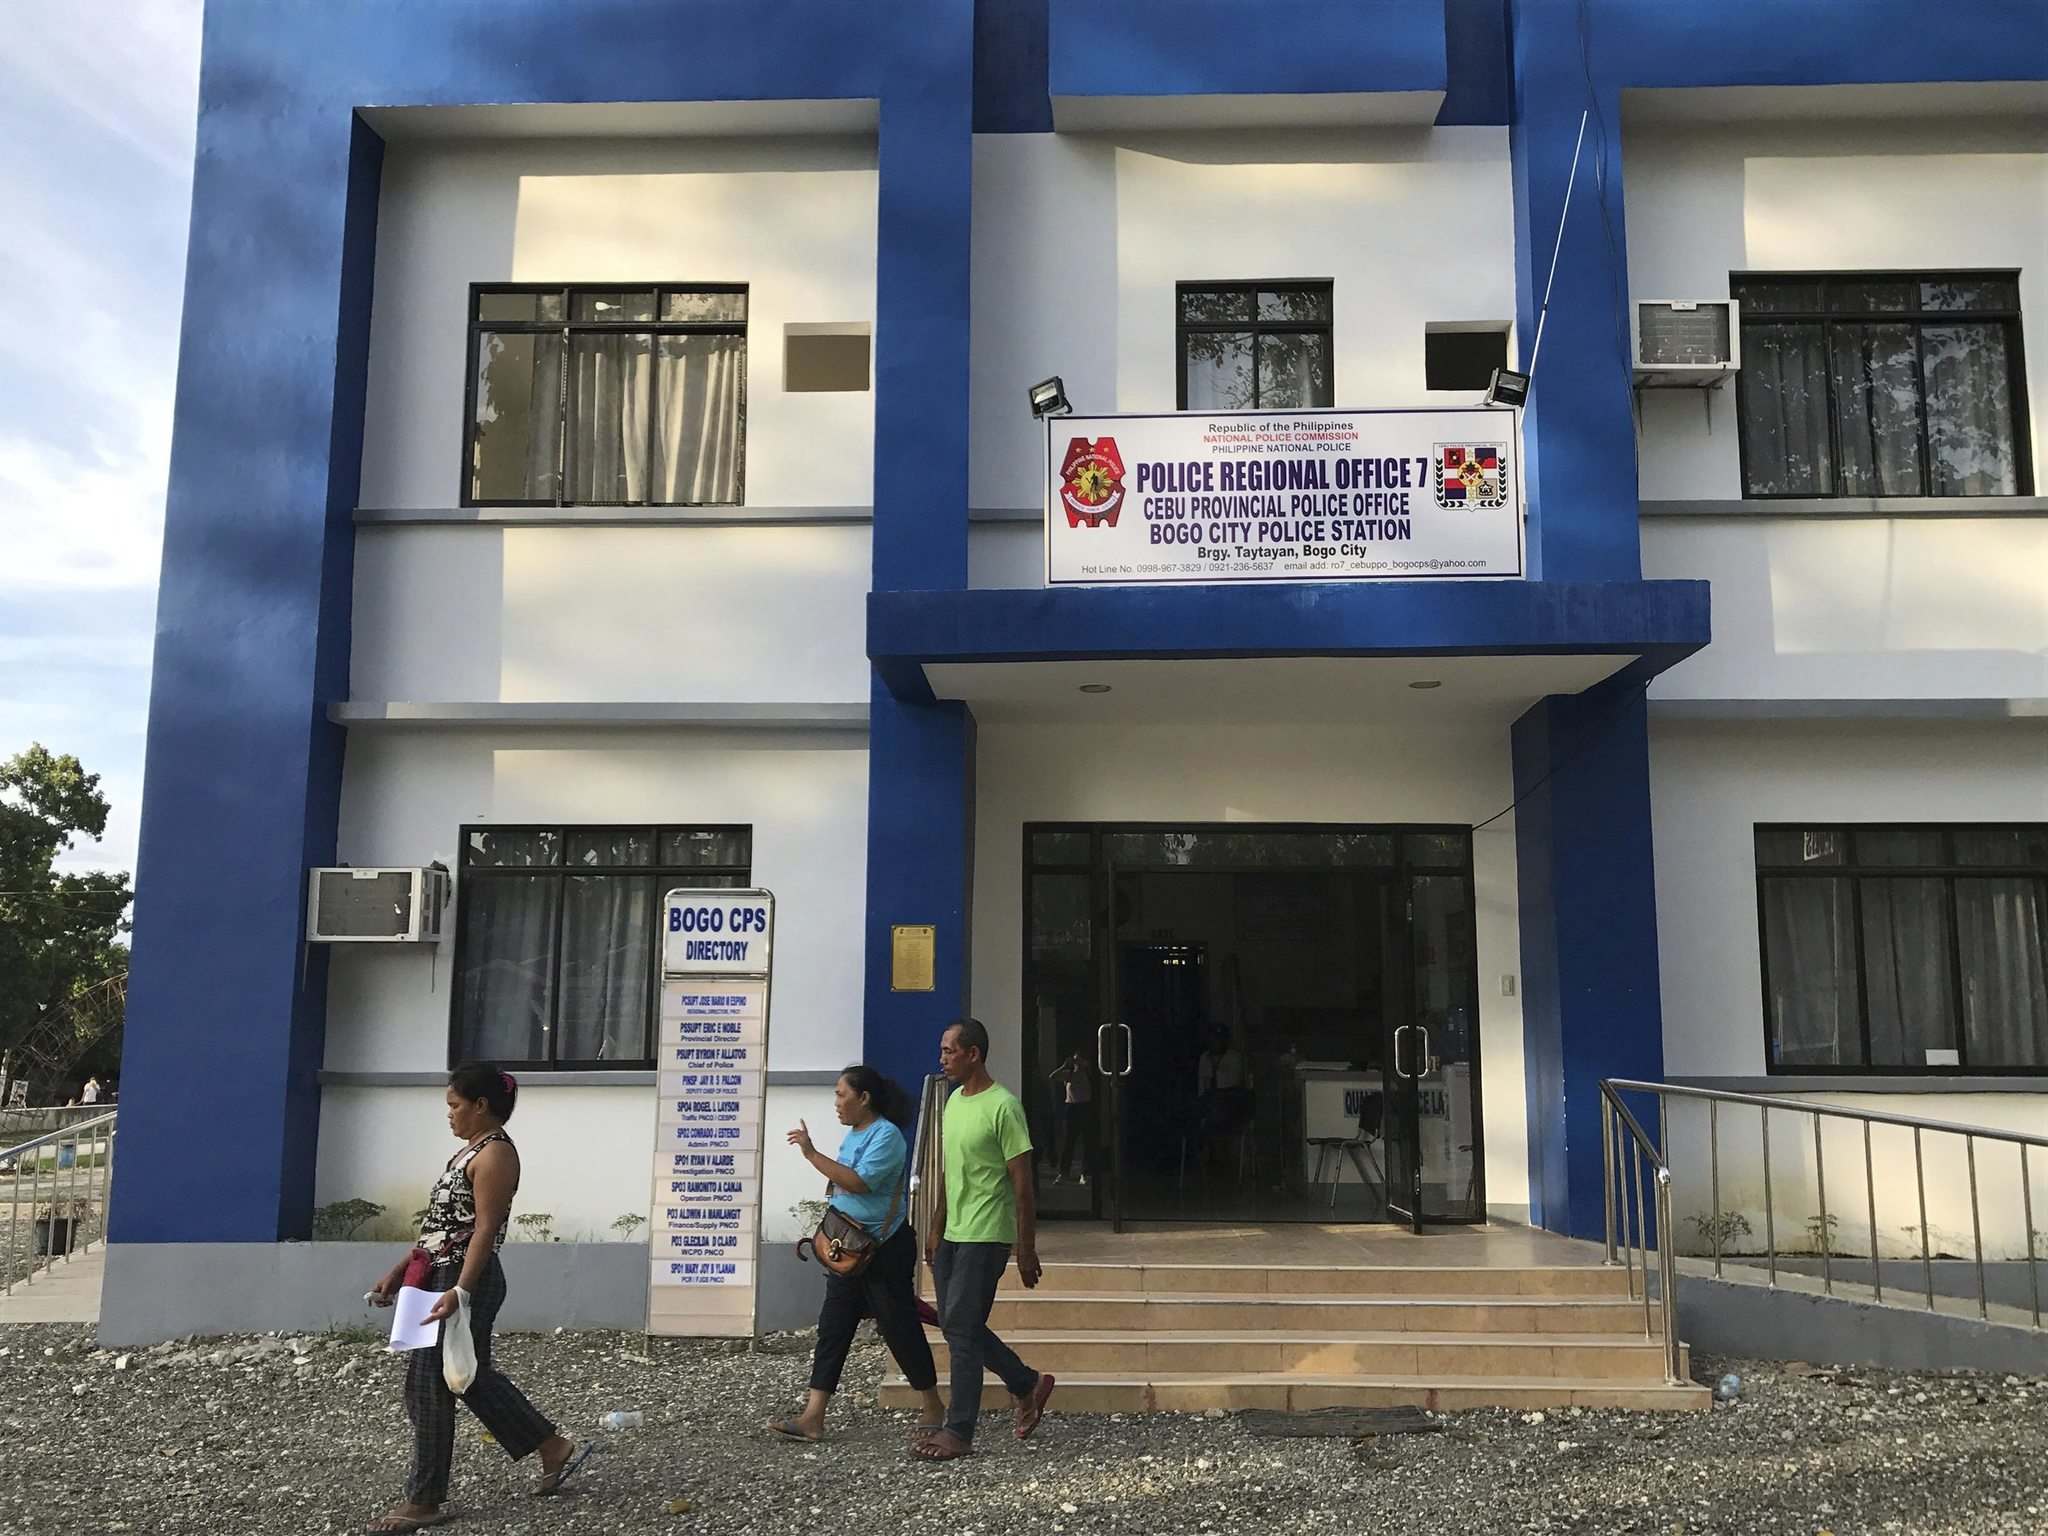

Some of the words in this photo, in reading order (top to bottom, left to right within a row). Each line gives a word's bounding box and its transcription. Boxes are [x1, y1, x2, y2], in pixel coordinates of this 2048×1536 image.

[1208, 423, 1256, 434] Republic
[1259, 422, 1270, 432] of
[1273, 422, 1290, 432] the
[1293, 422, 1353, 433] Philippines
[1203, 434, 1252, 443] NATIONAL
[1256, 433, 1292, 442] POLICE
[1294, 432, 1358, 442] COMMISSION
[1212, 444, 1264, 454] PHILIPPINE
[1266, 444, 1314, 452] NATIONAL
[1316, 442, 1350, 451] POLICE
[1137, 461, 1214, 493] POLICE
[1220, 460, 1330, 492] REGIONAL
[1335, 458, 1411, 490] OFFICE
[1416, 458, 1428, 488] 7
[1144, 497, 1185, 520] CEBU
[1191, 495, 1286, 519] PROVINCIAL
[1291, 494, 1348, 517] POLICE
[1353, 492, 1410, 516] OFFICE
[1150, 522, 1202, 544] BOGO
[1209, 522, 1251, 544] CITY
[1258, 520, 1325, 542] POLICE
[1331, 519, 1411, 541] STATION
[1198, 547, 1230, 561] Brgy.
[1235, 546, 1298, 560] Taytayan,
[1303, 544, 1336, 559] Bogo
[1341, 544, 1366, 558] City
[1082, 565, 1097, 574] Hot
[1099, 564, 1117, 574] Line
[1136, 563, 1202, 573] 0998-967-3829
[1284, 562, 1308, 570] email
[1310, 561, 1328, 570] add:
[1330, 558, 1486, 571] ro7_cebuppo_bogocps@yahoo.com
[669, 908, 724, 932] BOGO
[729, 908, 766, 932] CPS
[686, 940, 748, 960] DIRECTORY
[680, 1022, 702, 1033] PSSUPT
[673, 1168, 714, 1176] Investigation
